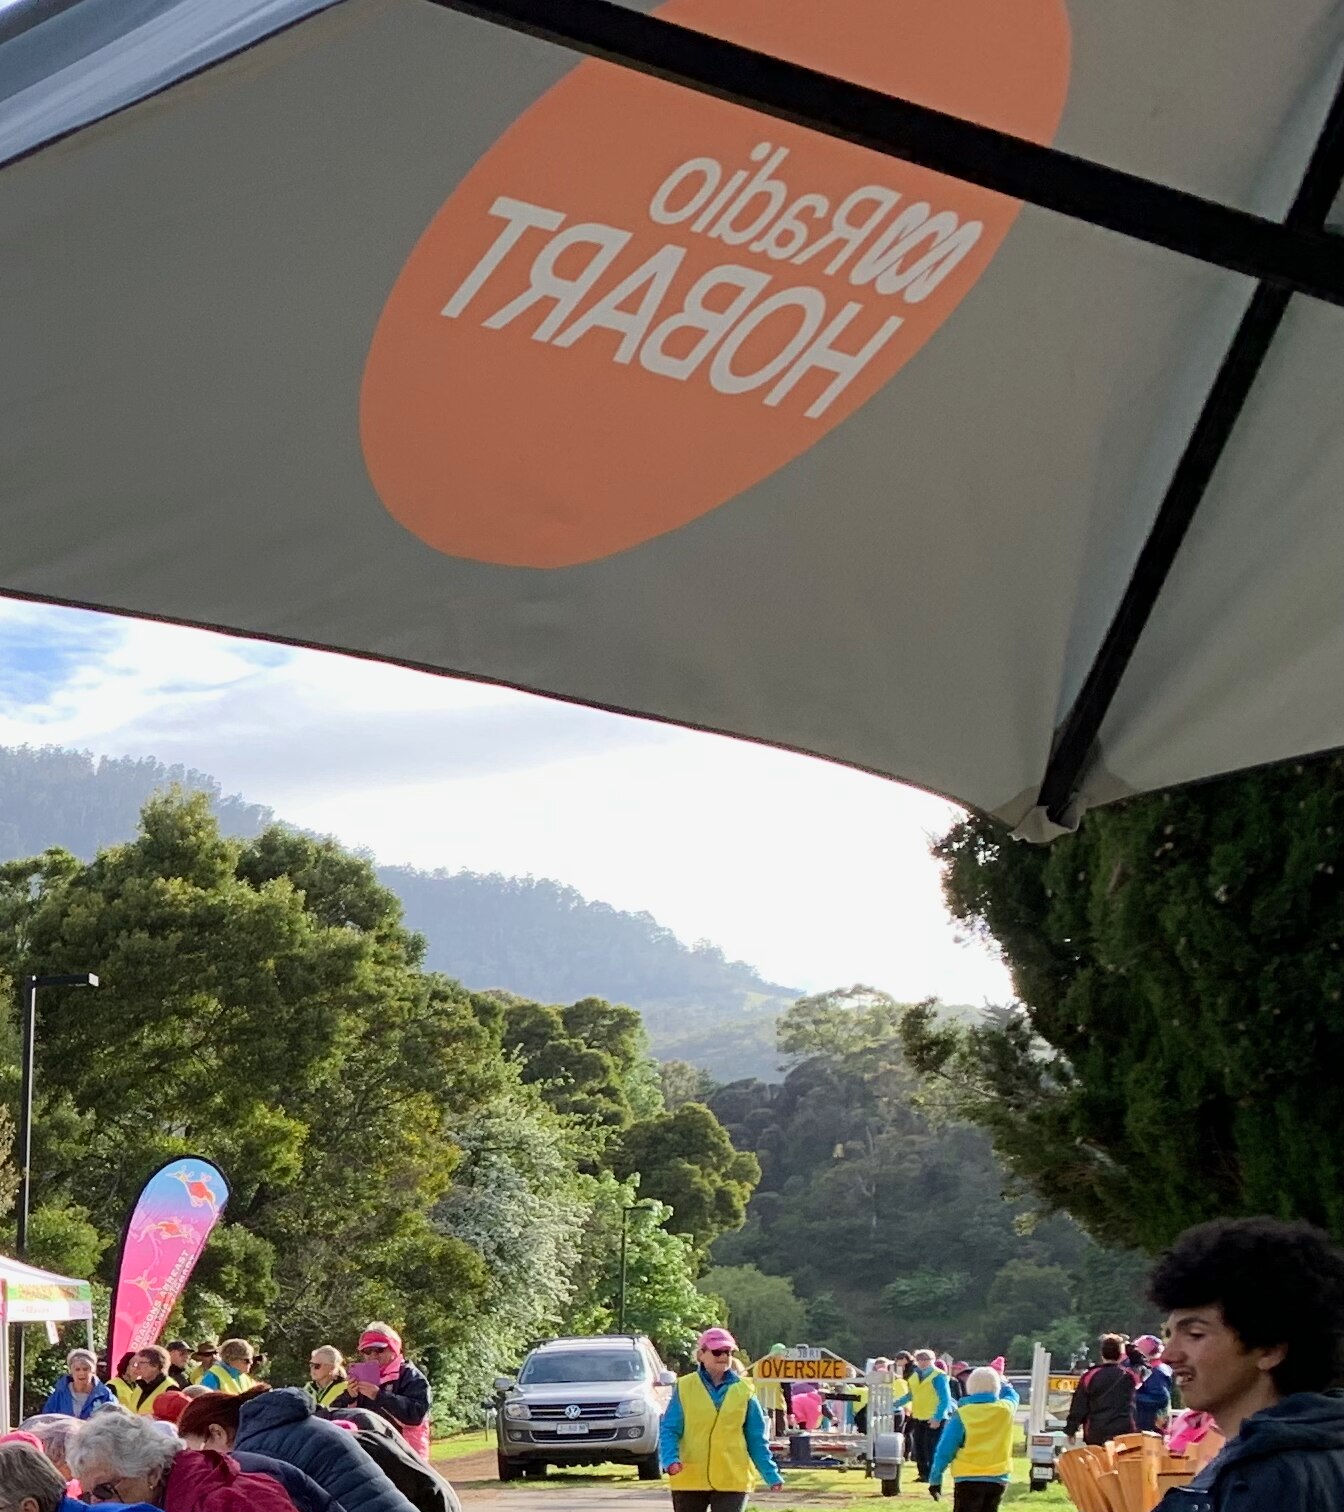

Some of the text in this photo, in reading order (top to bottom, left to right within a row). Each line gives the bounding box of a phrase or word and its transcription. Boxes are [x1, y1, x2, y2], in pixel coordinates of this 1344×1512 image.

[130, 1249, 189, 1350] DRAGONS ABREAST
[761, 1359, 843, 1379] OVERSIZE
